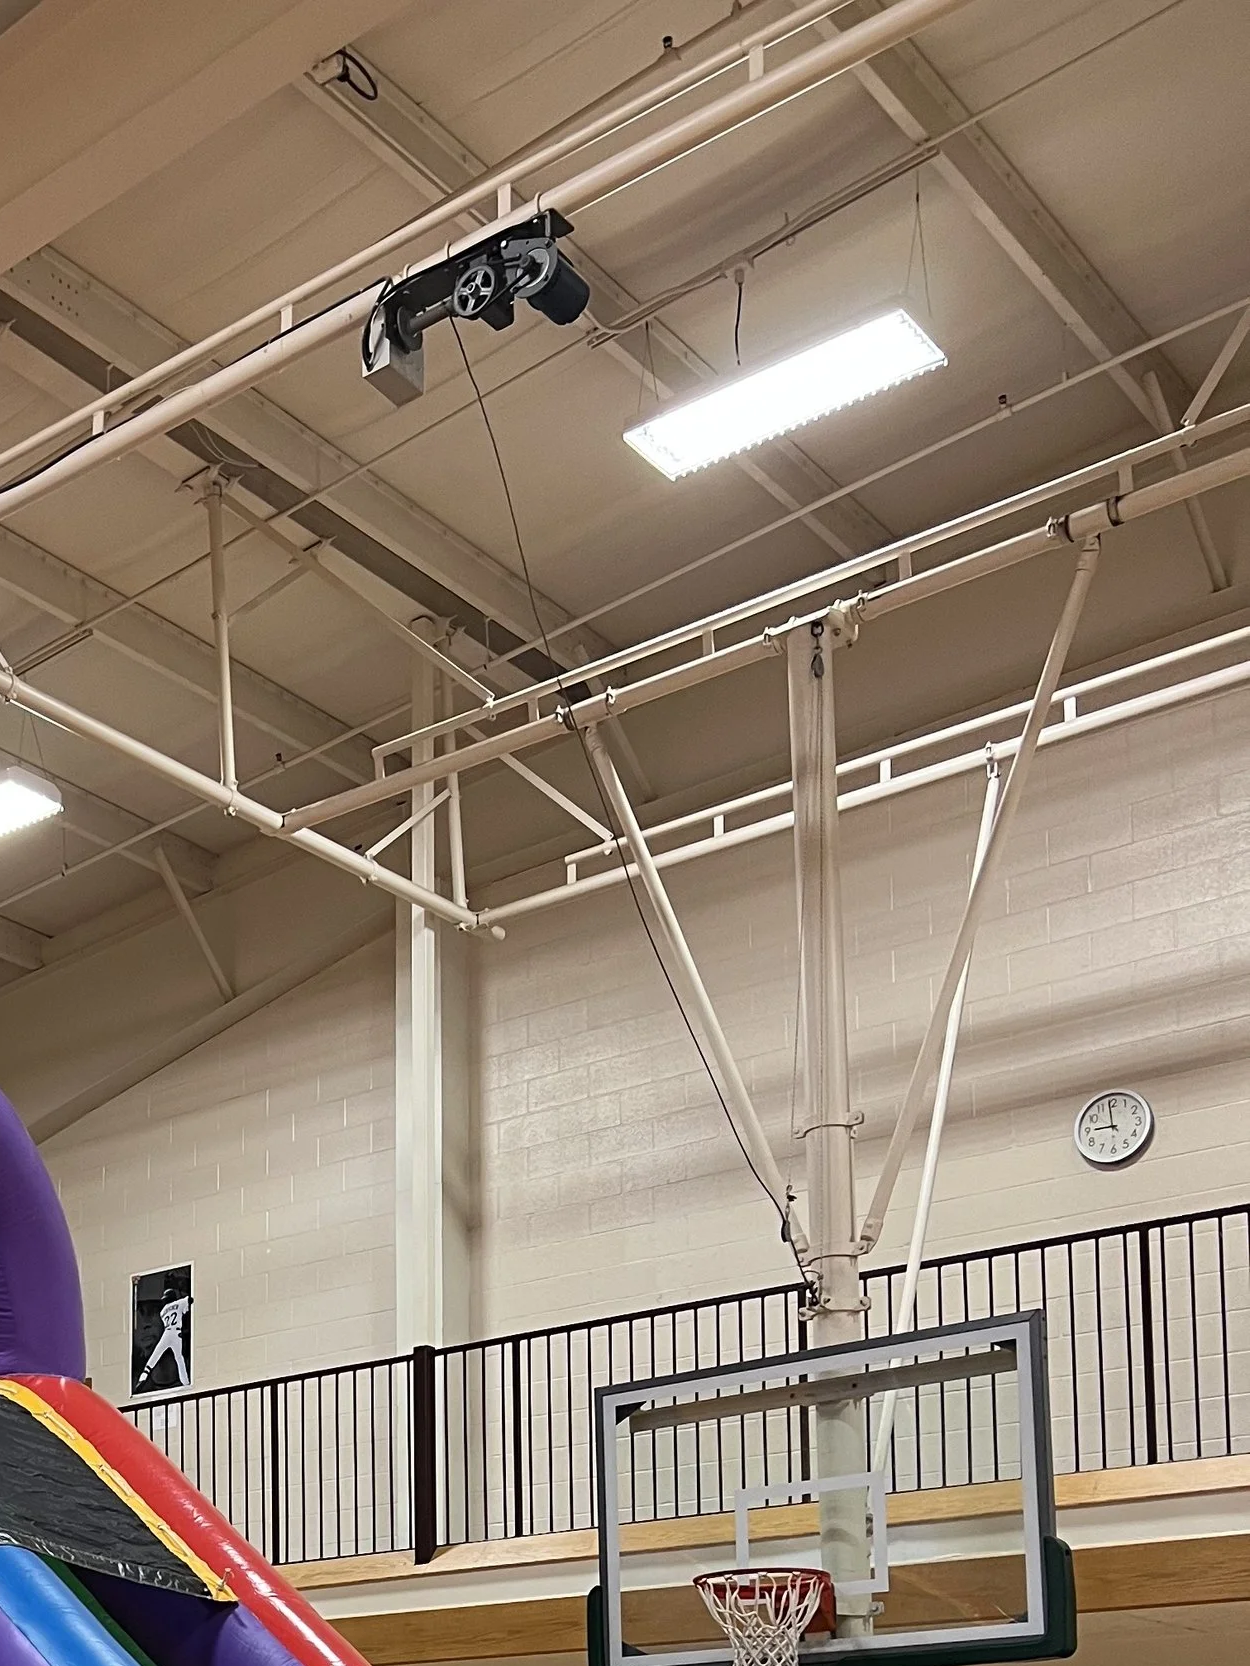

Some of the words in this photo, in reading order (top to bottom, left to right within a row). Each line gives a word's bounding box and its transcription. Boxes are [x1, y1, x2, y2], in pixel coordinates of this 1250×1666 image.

[1108, 1098, 1117, 1108] 2
[1097, 1103, 1105, 1114] 11
[1131, 1105, 1138, 1115] 2
[1089, 1114, 1099, 1124] 10
[1135, 1116, 1142, 1126] 3
[1084, 1127, 1091, 1136] 9
[1131, 1129, 1137, 1138] 4
[1088, 1137, 1095, 1146] 8
[1122, 1139, 1129, 1149] 5
[1099, 1143, 1105, 1153] 7
[1110, 1144, 1117, 1154] 6
